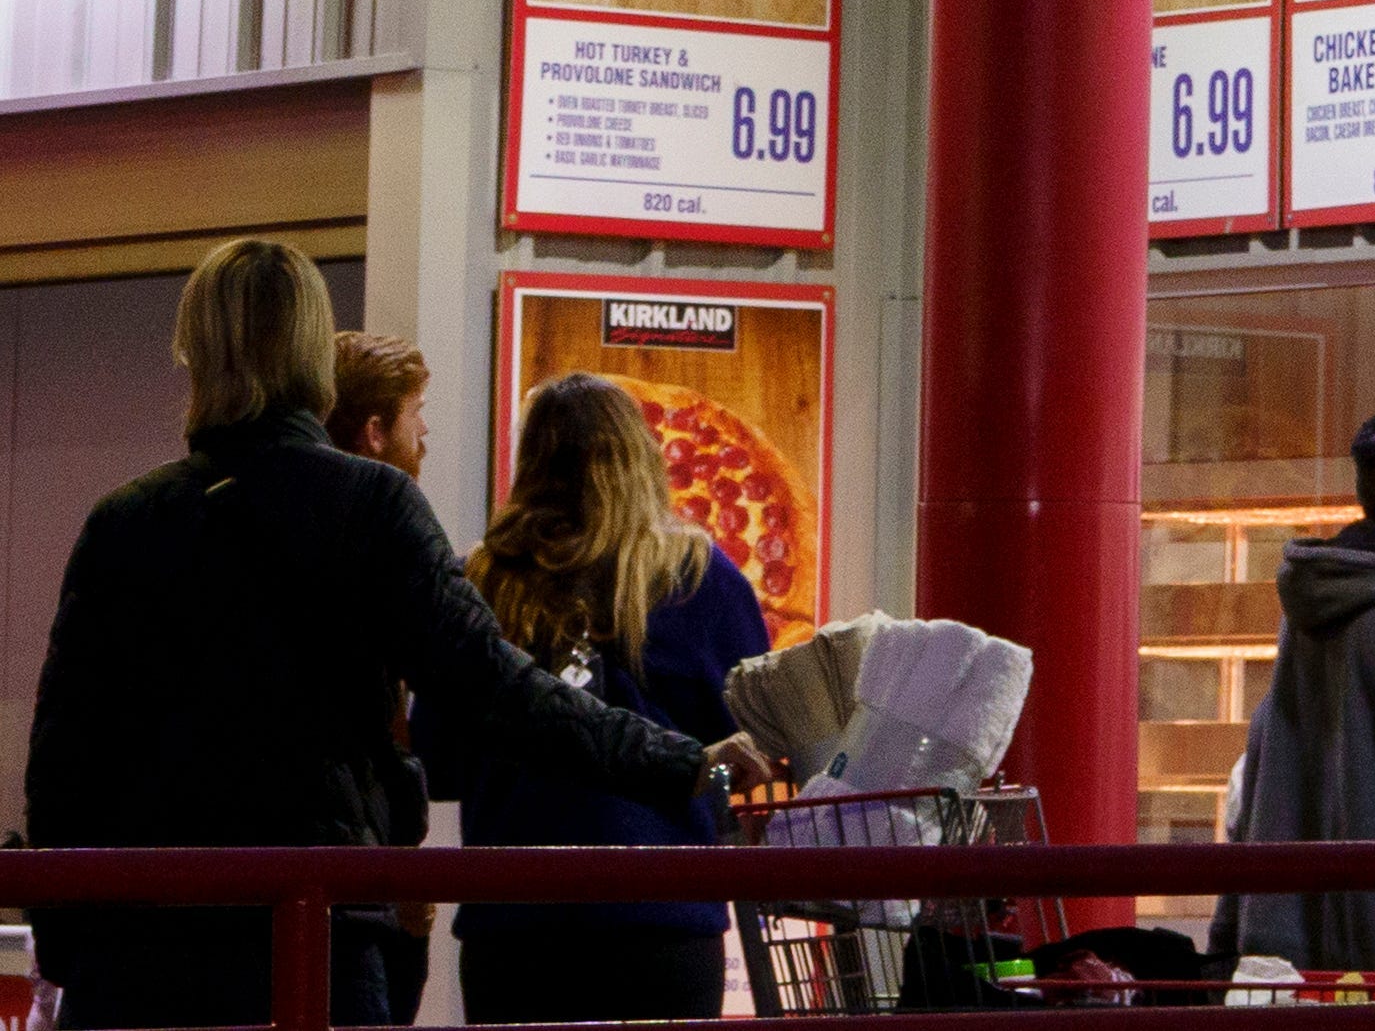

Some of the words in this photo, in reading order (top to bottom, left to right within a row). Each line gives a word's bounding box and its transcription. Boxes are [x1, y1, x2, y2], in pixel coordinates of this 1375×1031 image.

[575, 41, 605, 61] HOT
[612, 44, 672, 66] TURKEY
[678, 49, 688, 66] &
[540, 62, 633, 86] PROVOLONE
[639, 70, 721, 93] SANDWICH
[1328, 63, 1375, 94] BAKE
[732, 86, 817, 163] 6.99
[1171, 67, 1254, 159] 6.99
[643, 193, 671, 212] 820
[677, 196, 706, 214] cal.
[1152, 190, 1178, 213] cal.
[609, 302, 732, 332] KIRKLAND
